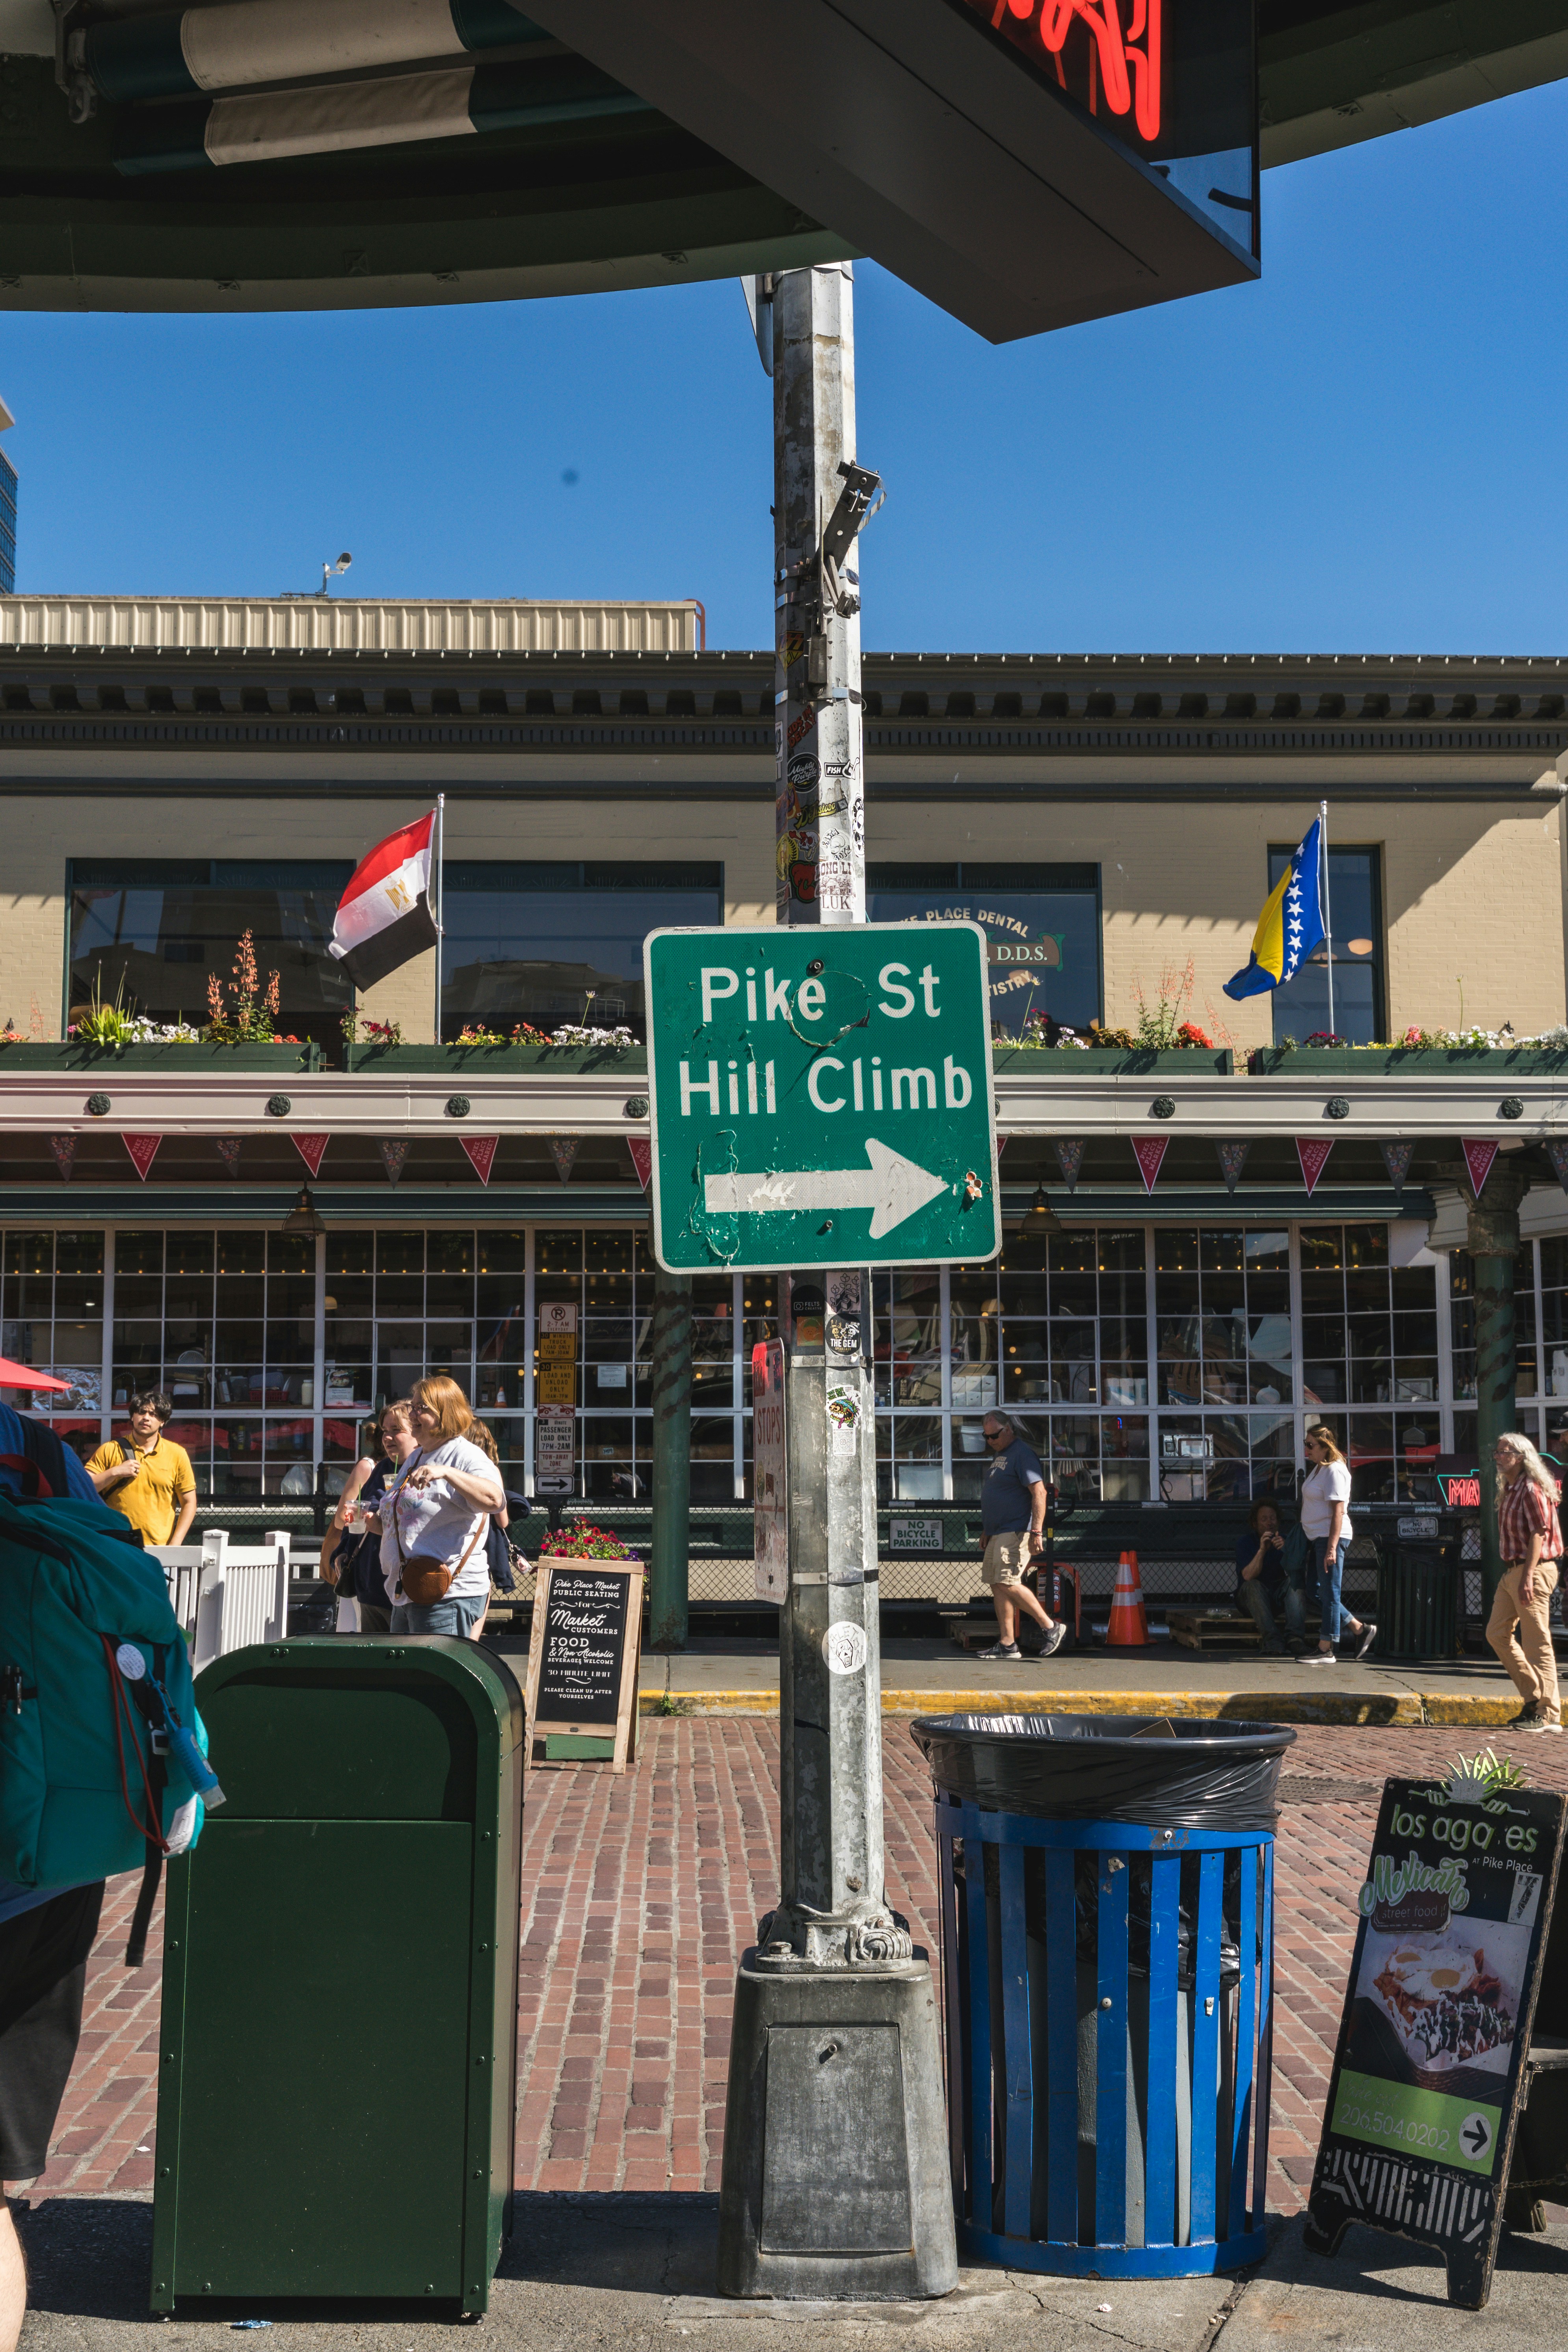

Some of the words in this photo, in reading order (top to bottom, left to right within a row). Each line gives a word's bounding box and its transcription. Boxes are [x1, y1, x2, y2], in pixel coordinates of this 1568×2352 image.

[788, 713, 816, 748] DECAY
[787, 761, 815, 776] Mighty
[792, 767, 817, 784] Purple
[926, 907, 971, 921] PLACE
[978, 909, 1029, 938] DENTAL
[997, 946, 1048, 961] D.D.S.
[701, 967, 826, 1022] Pike
[878, 962, 941, 1018] St
[988, 970, 1032, 997] TISTRY
[679, 1059, 776, 1116] Hill
[807, 1054, 972, 1113] Climb
[132, 1138, 142, 1153] PIKE
[137, 1138, 150, 1157] PLACE
[143, 1138, 157, 1161] MARKET
[471, 1141, 480, 1156] PIKE
[476, 1140, 487, 1161] PLACE
[482, 1139, 494, 1165] MARKET
[635, 1143, 646, 1159] PIKE
[1140, 1142, 1150, 1160] PIKE
[1144, 1141, 1157, 1165] PLACE
[1149, 1140, 1164, 1171] MARKET
[1303, 1143, 1315, 1161] PIKE
[1307, 1144, 1321, 1167] PLACE
[1469, 1145, 1480, 1162] PIKE
[1311, 1143, 1328, 1173] MARKET
[1473, 1145, 1487, 1168] PLACE
[1478, 1143, 1494, 1174] MARKET
[830, 1338, 841, 1347] THE
[843, 1339, 857, 1348] GEM
[757, 1406, 780, 1445] STOPS
[897, 1530, 936, 1538] BICYCLE
[908, 1520, 924, 1529] NO
[893, 1538, 939, 1548] PARKING
[554, 1579, 571, 1588] Pike
[573, 1580, 593, 1589] Place
[595, 1581, 621, 1590] Market
[551, 1609, 606, 1630] Market
[549, 1647, 557, 1656] &
[550, 1637, 589, 1647] FOOD
[1390, 1804, 1427, 1839] los
[1482, 1856, 1503, 1870] Pike
[1505, 1859, 1533, 1873] Place
[1358, 1850, 1469, 1917] Mexican
[1382, 1907, 1411, 1919] street
[1414, 1905, 1438, 1917] food
[1339, 2103, 1450, 2153] 206.504.0202
